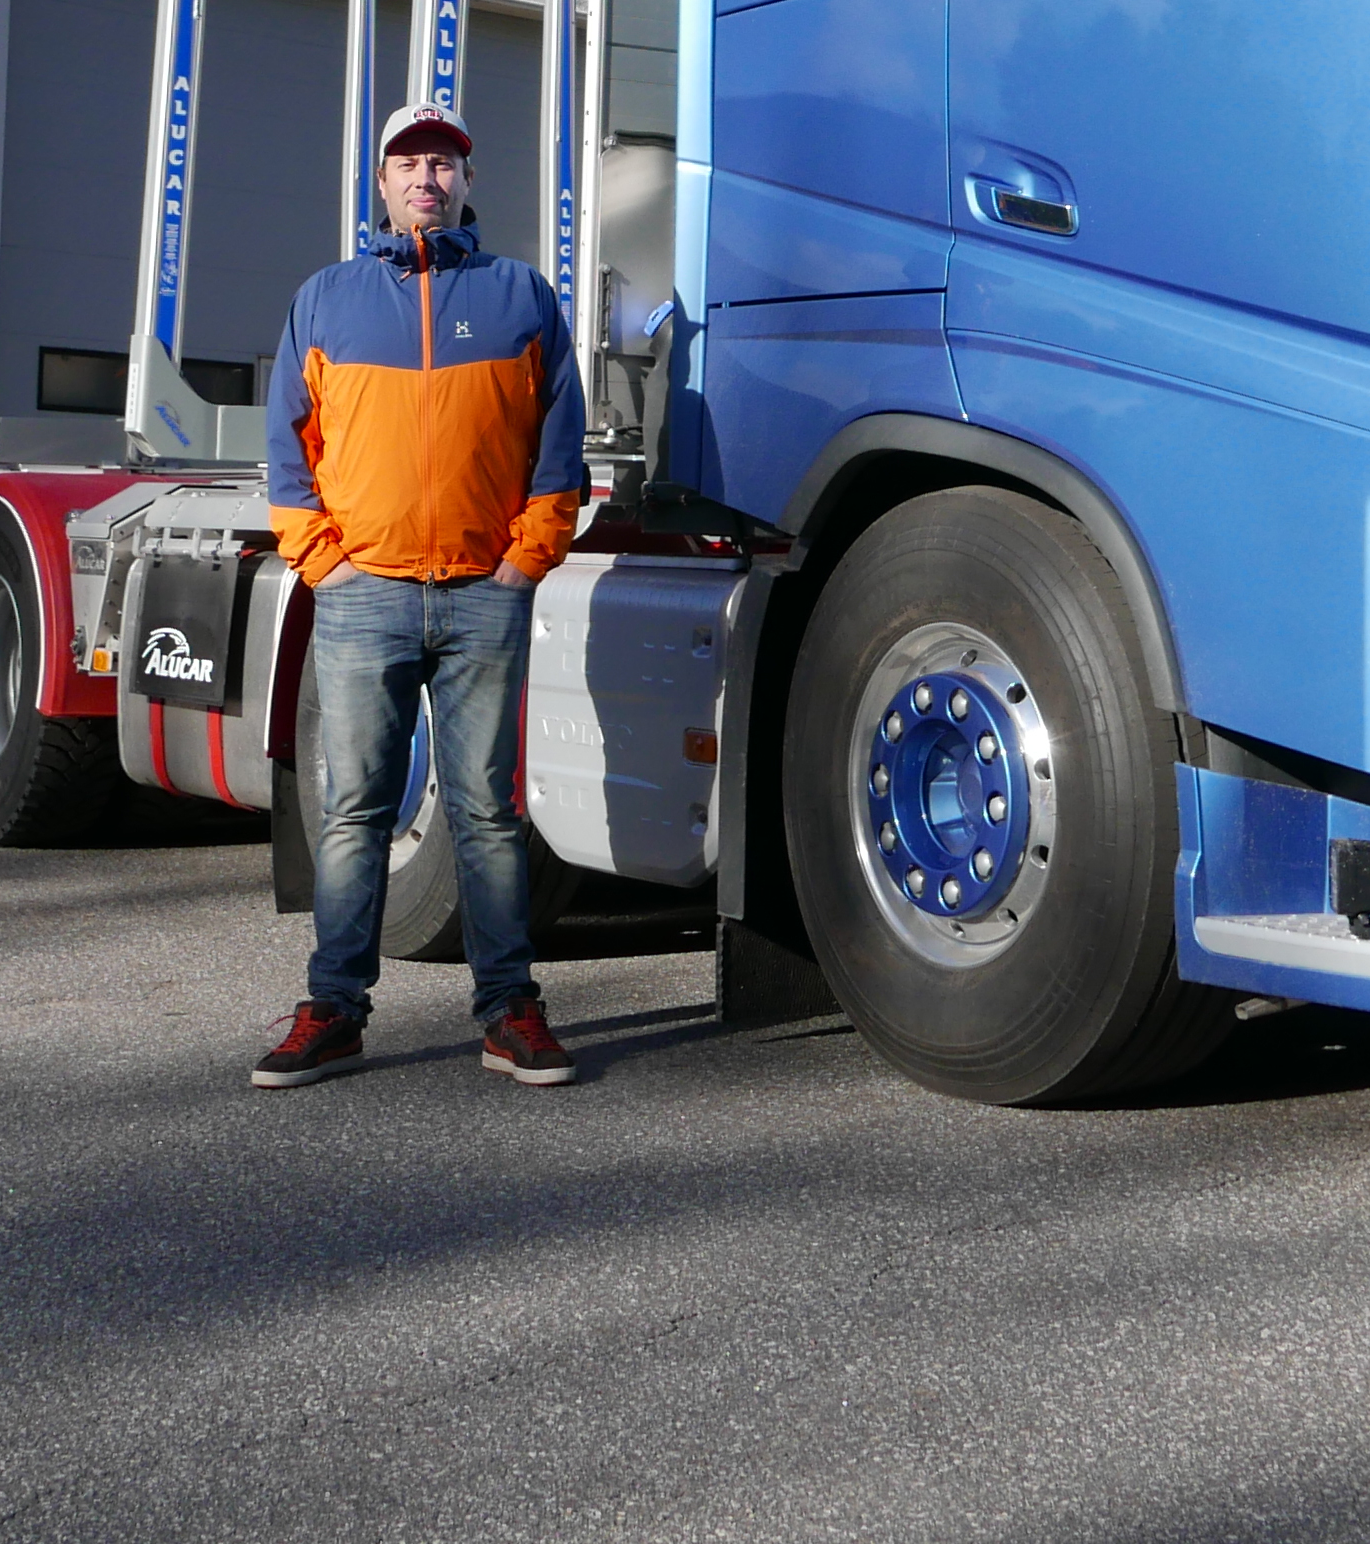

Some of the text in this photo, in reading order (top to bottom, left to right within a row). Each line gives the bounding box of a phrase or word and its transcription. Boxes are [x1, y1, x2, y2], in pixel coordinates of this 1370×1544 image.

[434, 0, 457, 107] ALUC
[166, 75, 190, 217] ALUCAR
[559, 188, 573, 295] ALUCAR
[76, 556, 106, 571] ALUCAR
[144, 647, 214, 683] ALUCAR
